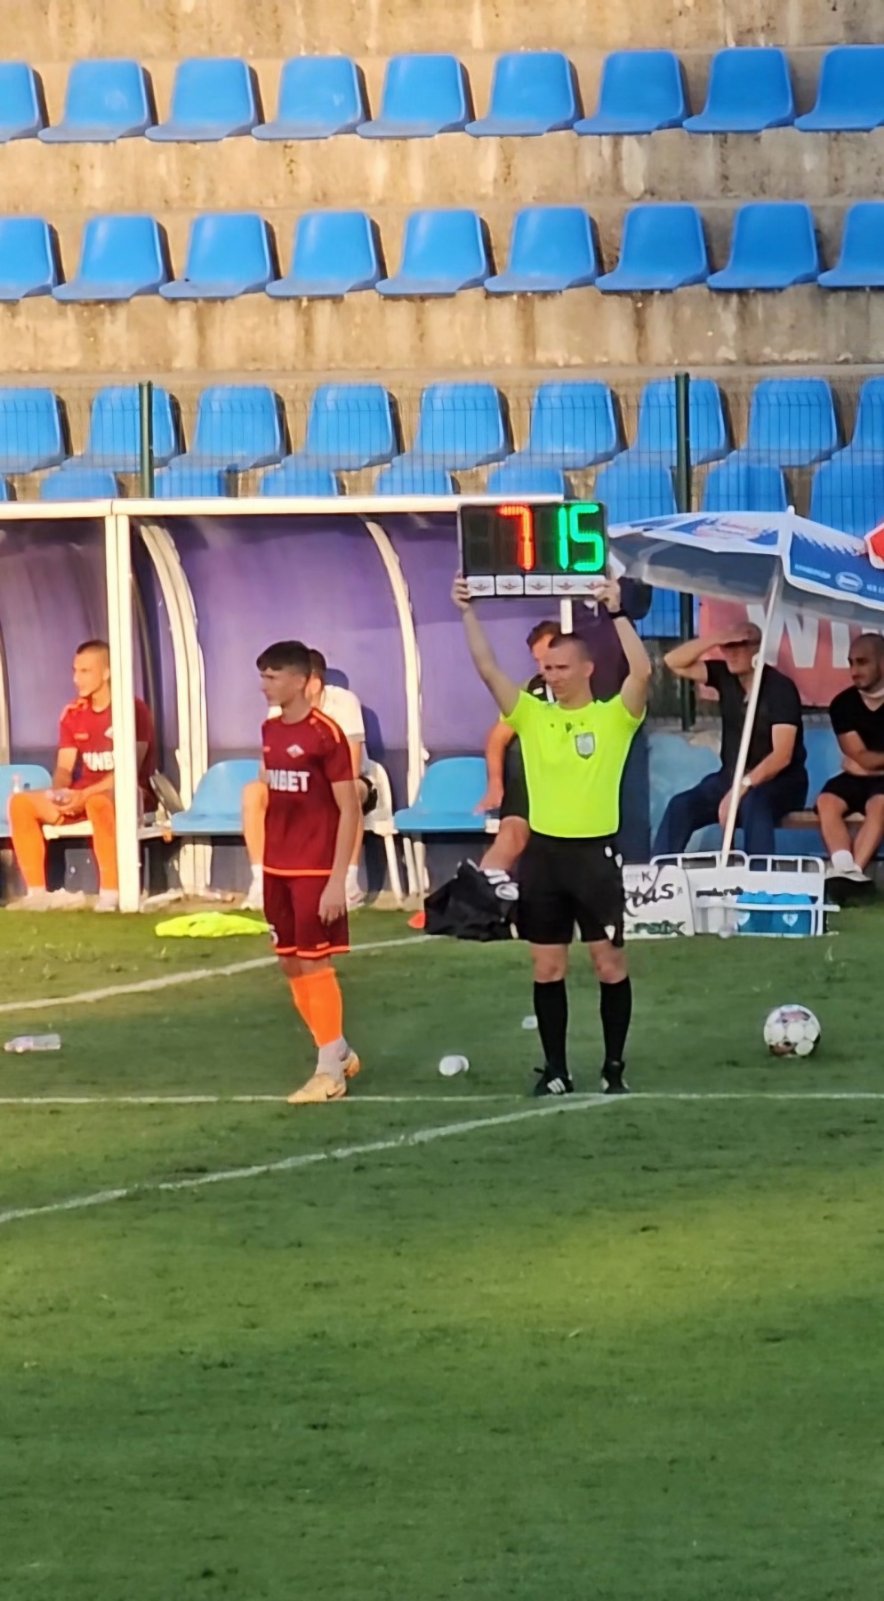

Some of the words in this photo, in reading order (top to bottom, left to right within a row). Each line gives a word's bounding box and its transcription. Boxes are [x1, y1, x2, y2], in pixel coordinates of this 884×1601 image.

[499, 504, 534, 570] 7
[557, 503, 604, 572] 15
[746, 603, 884, 668] WI
